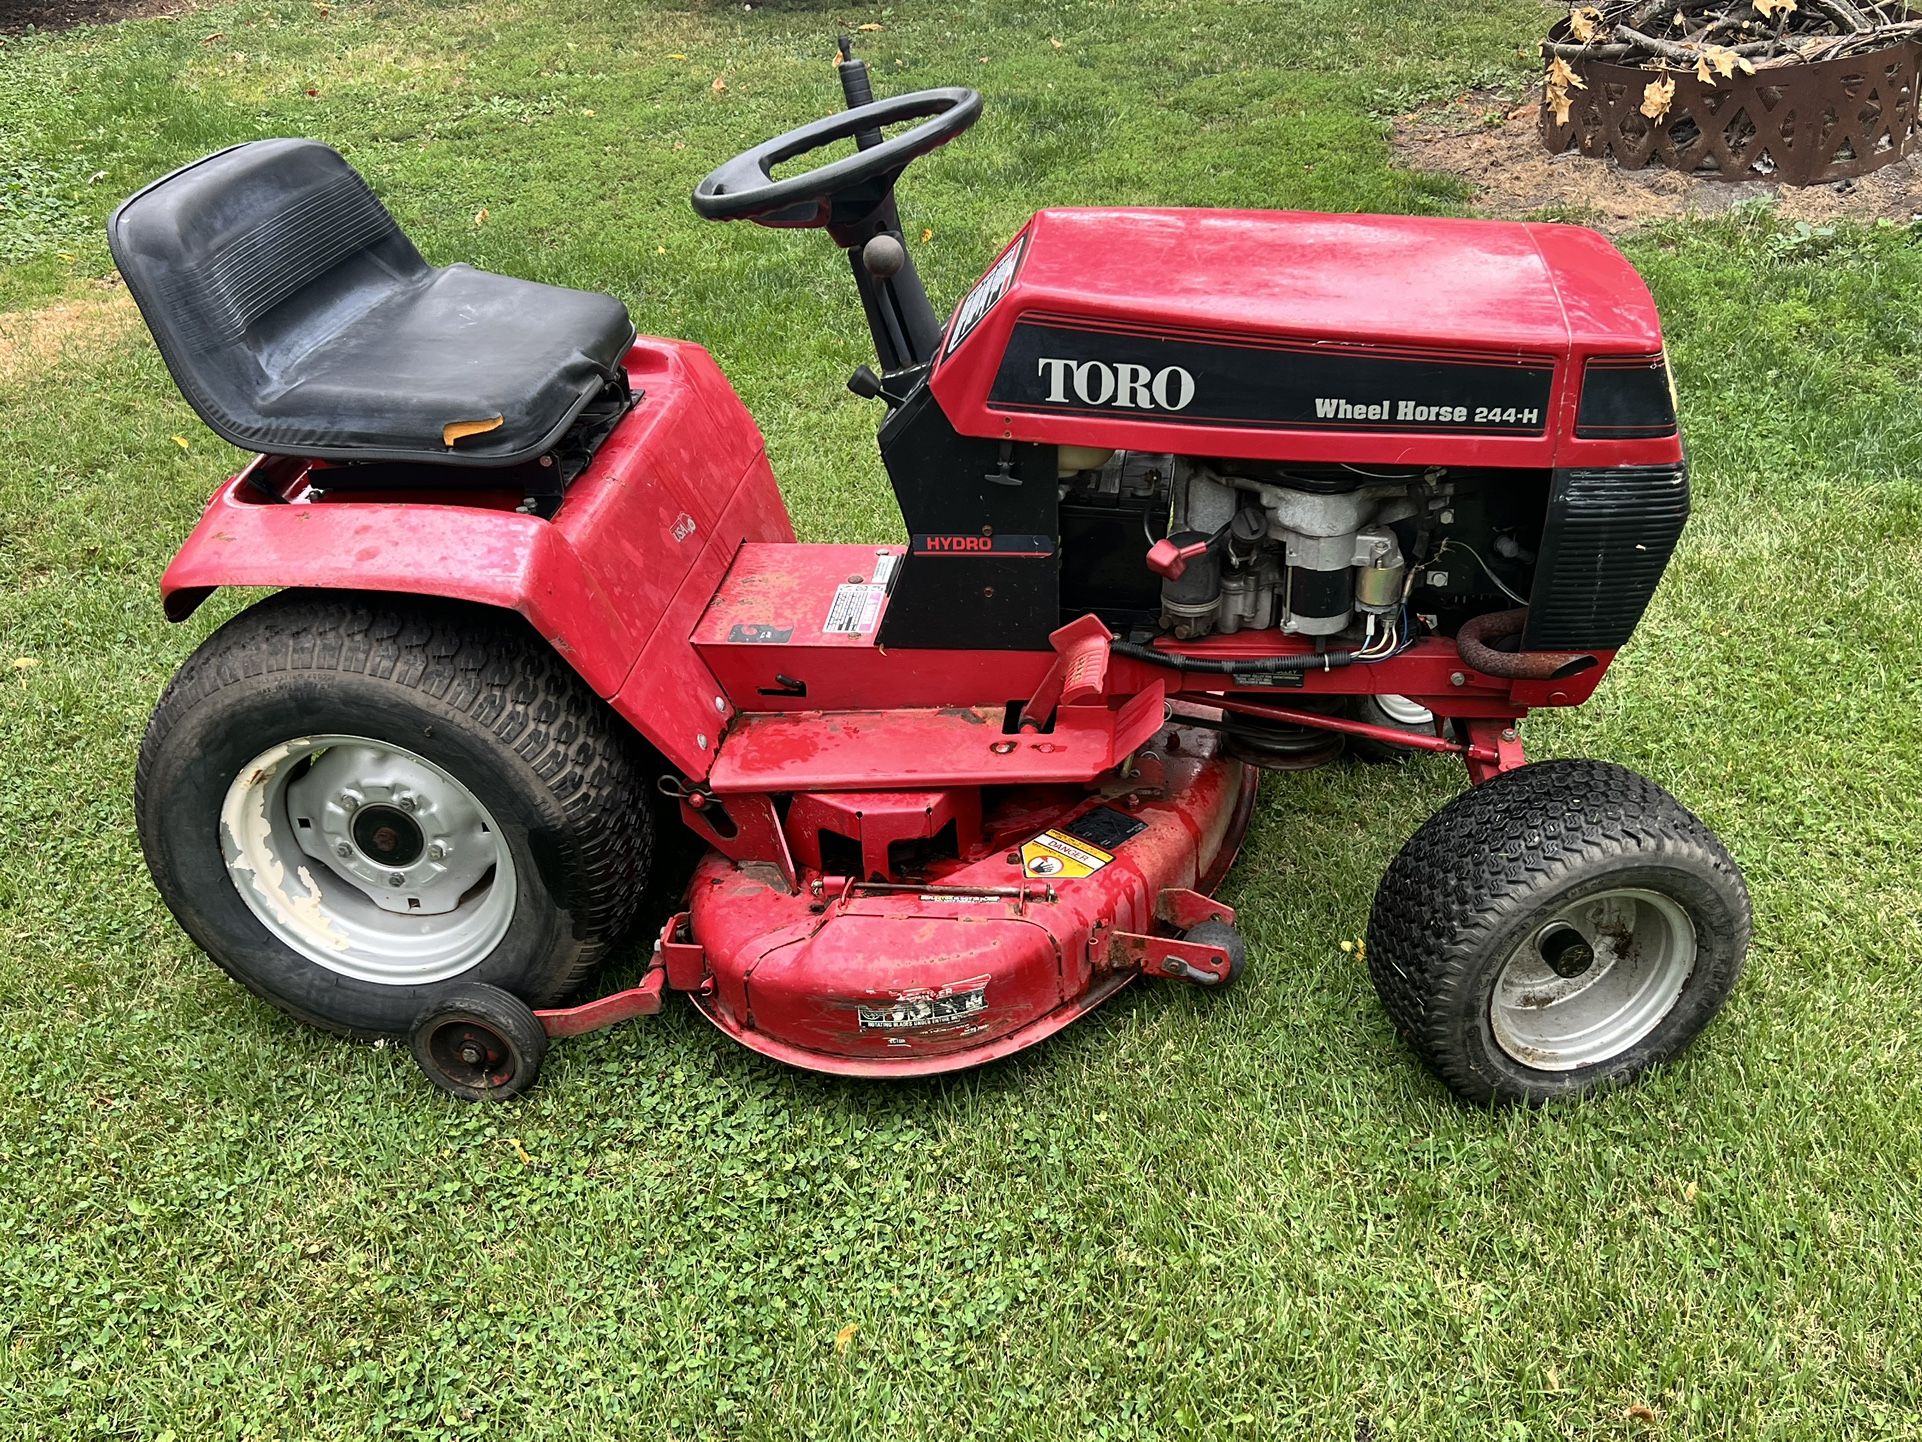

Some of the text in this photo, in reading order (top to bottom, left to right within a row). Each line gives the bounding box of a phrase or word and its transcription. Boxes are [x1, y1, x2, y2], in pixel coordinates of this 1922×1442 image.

[1038, 358, 1195, 411] TORO
[1315, 398, 1539, 424] Wheel Horse 244-H
[926, 536, 992, 551] HYDRO
[1048, 840, 1089, 862] DANGER
